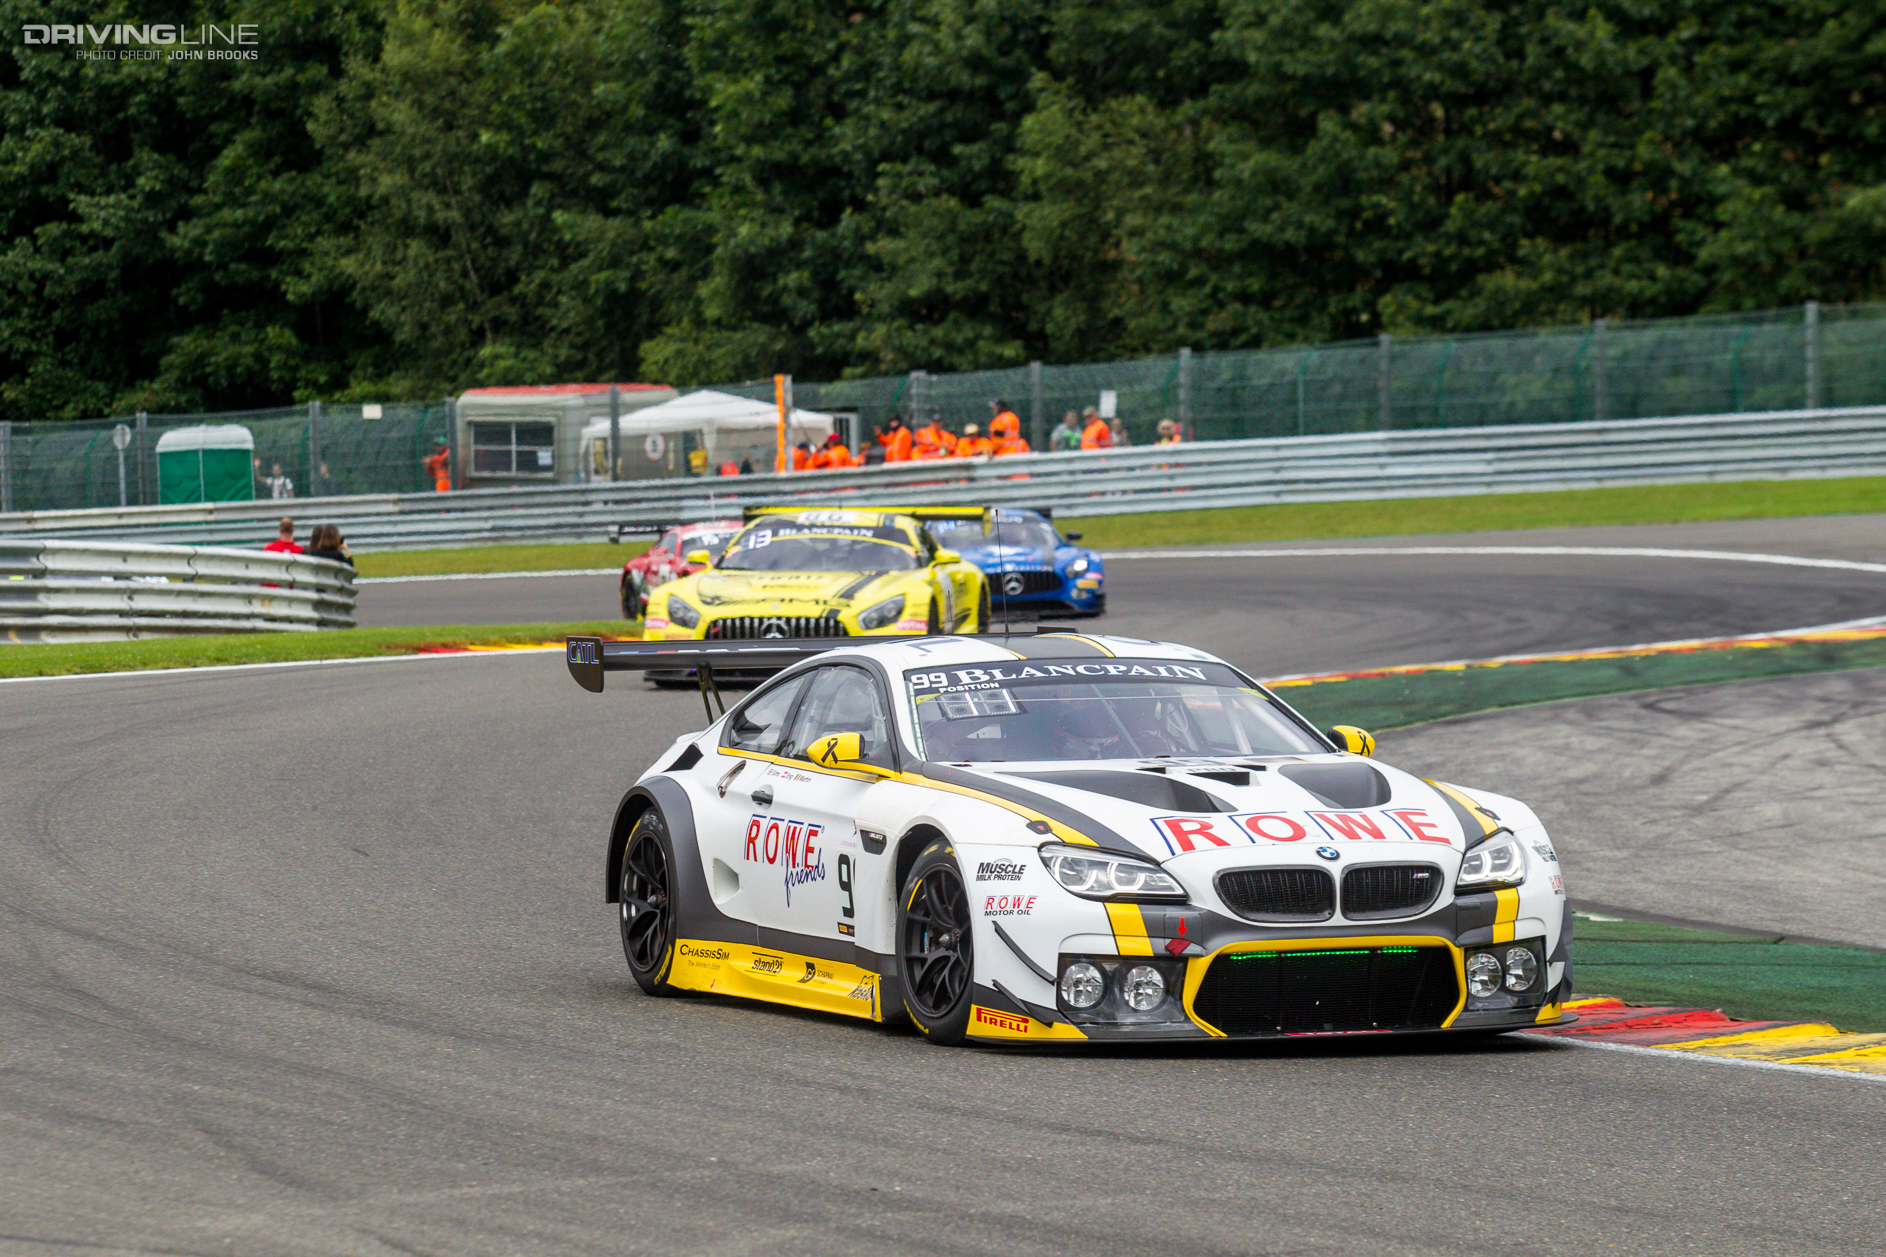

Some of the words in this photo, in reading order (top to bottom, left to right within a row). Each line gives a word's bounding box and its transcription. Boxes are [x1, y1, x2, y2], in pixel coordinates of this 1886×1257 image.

[748, 529, 772, 549] 13
[568, 641, 599, 664] CATL
[910, 673, 948, 689] 99
[951, 664, 1207, 685] BLANCPAIN
[939, 682, 1000, 693] POSITION
[1163, 810, 1453, 852] ROWE
[745, 818, 819, 872] ROWE
[784, 847, 825, 908] friends
[976, 874, 993, 882] MILK
[993, 873, 1023, 881] PROTEIN
[977, 862, 1027, 875] MUSCLE
[984, 909, 1015, 917] MOTOR
[985, 896, 1037, 910] ROWE
[976, 1006, 1030, 1034] PIRELLI
